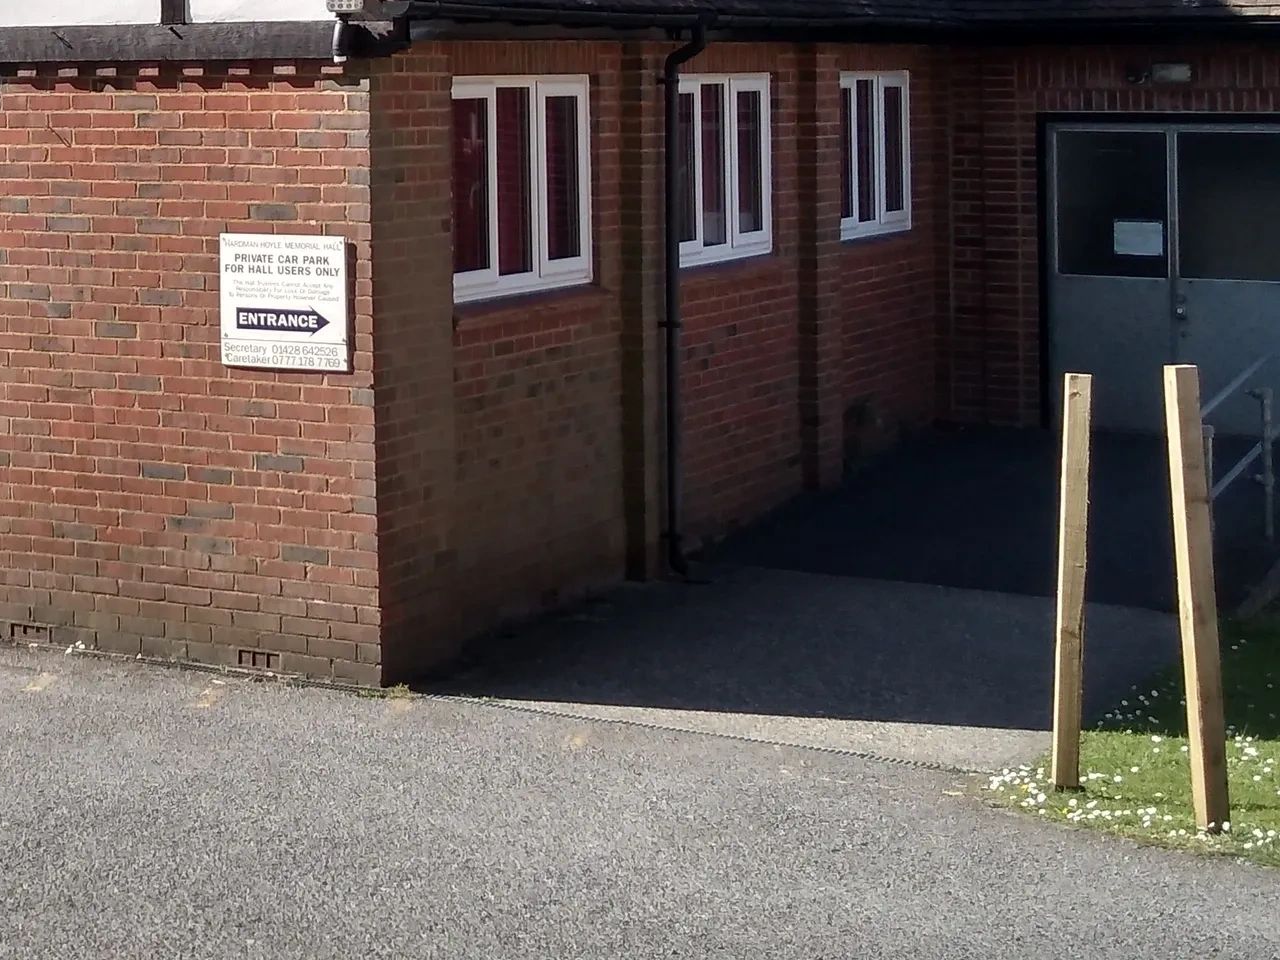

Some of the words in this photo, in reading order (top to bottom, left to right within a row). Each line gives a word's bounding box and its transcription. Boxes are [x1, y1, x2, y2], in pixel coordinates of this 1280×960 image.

[234, 254, 273, 263] PRIVATE
[278, 255, 298, 264] CAR
[303, 256, 329, 265] PARK
[225, 264, 244, 273] FOR
[249, 265, 273, 274] HALL
[278, 266, 311, 276] USERS
[316, 267, 340, 276] ONLY
[239, 312, 318, 328] ENTRANCE
[224, 342, 267, 355] Secretary
[272, 345, 300, 355] 01428
[302, 346, 338, 356] 642526
[227, 353, 270, 364] Caretaker
